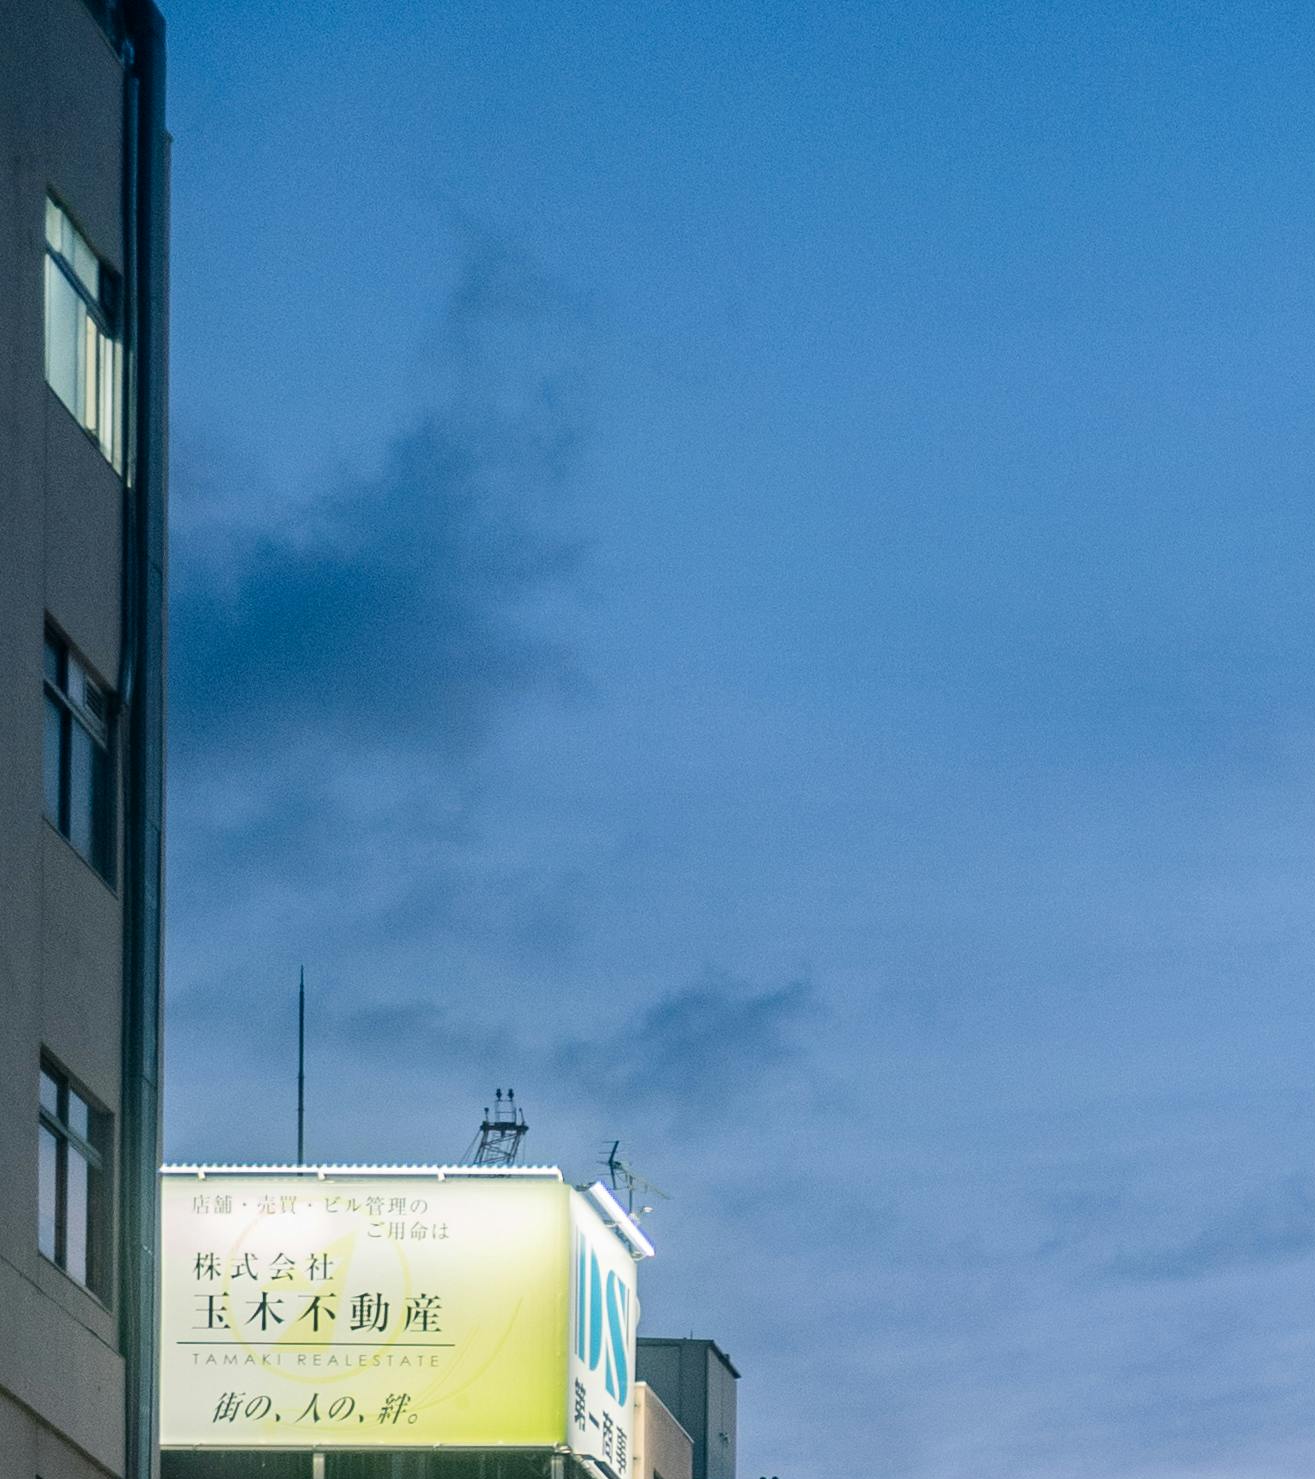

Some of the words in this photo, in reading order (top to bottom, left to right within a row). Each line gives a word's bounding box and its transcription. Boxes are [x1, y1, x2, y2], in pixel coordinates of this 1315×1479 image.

[192, 1195, 429, 1216] 店舗・売買・ビル管理の
[367, 1221, 450, 1242] ご用命は
[192, 1251, 335, 1281] 株式会社
[192, 1291, 443, 1333] 玉木不動産
[192, 1353, 282, 1366] TAMAKI
[298, 1353, 440, 1368] REALESTATE
[211, 1391, 418, 1425] 街の、人の、絆。
